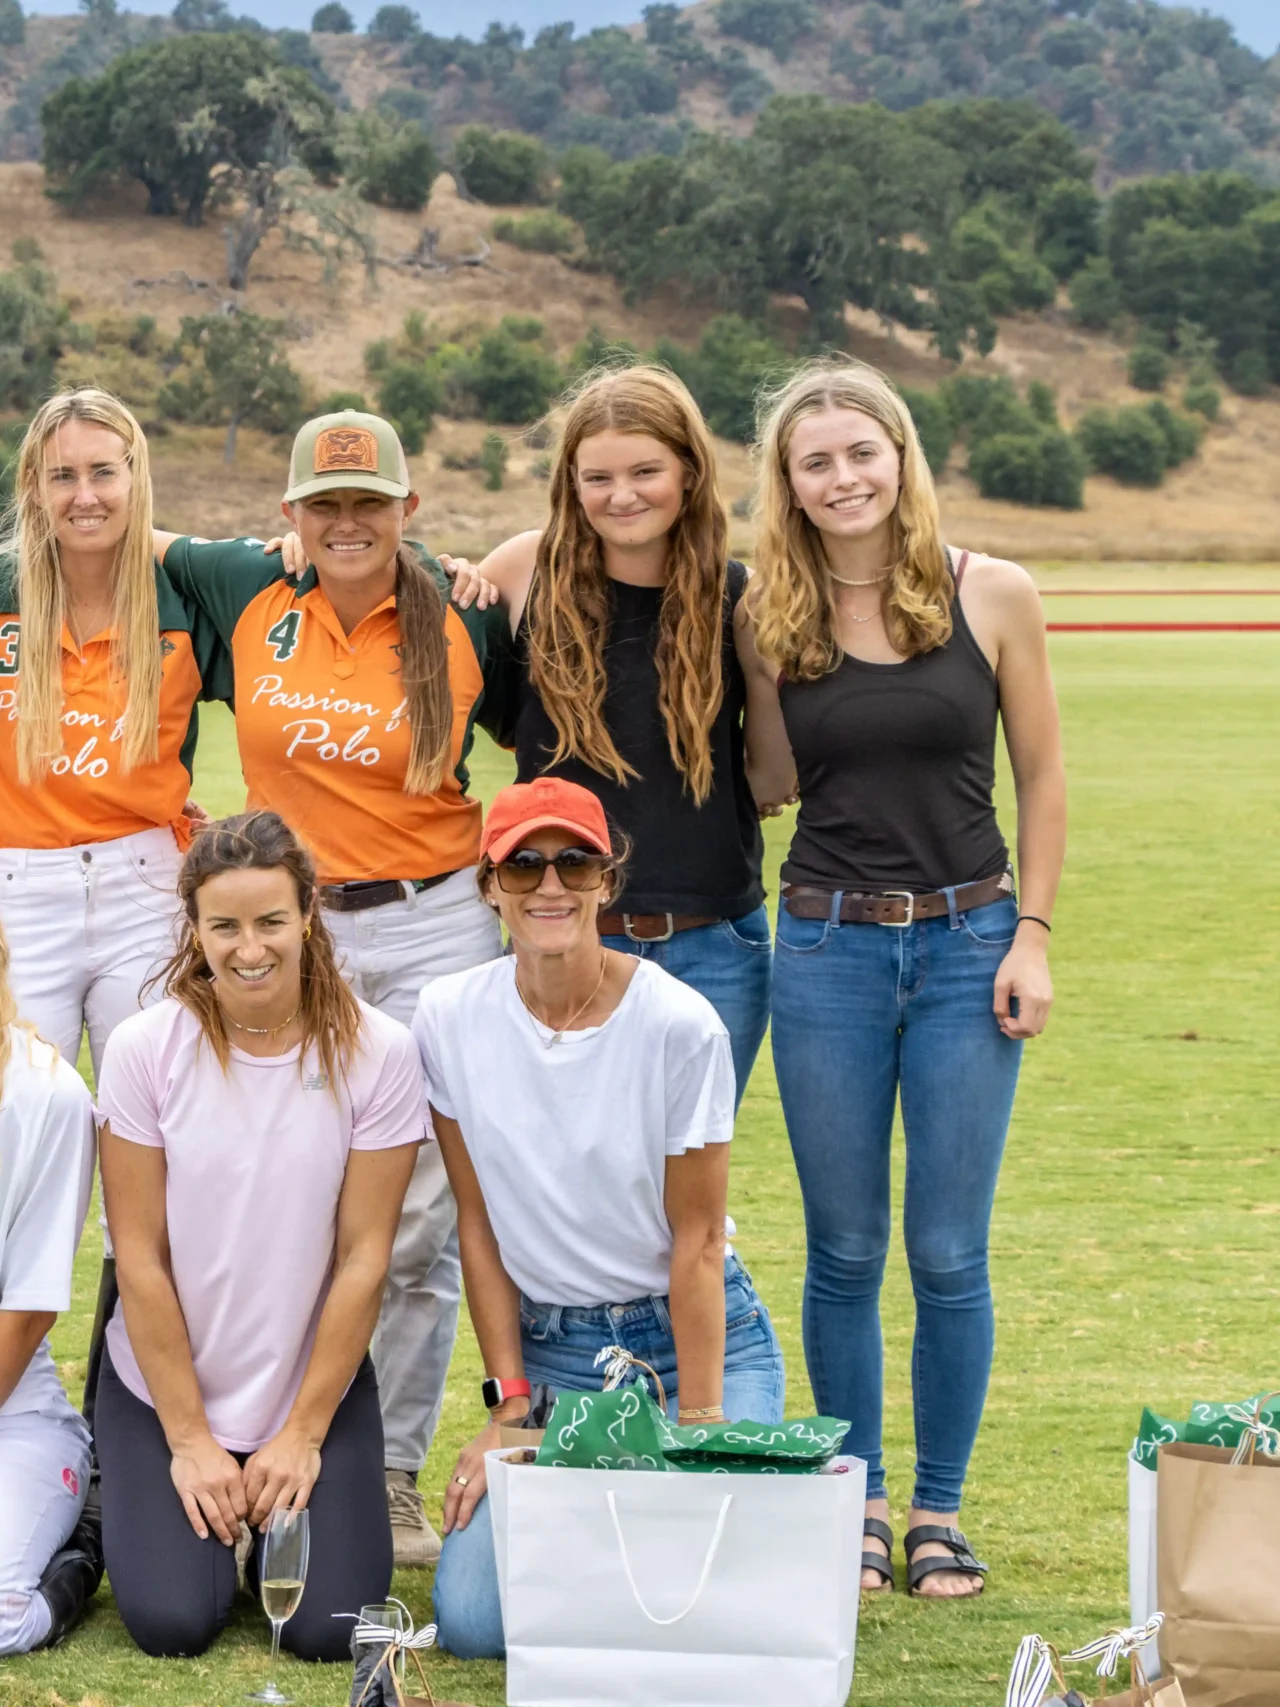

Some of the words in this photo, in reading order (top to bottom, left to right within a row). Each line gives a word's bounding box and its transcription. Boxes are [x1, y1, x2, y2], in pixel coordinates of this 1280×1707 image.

[265, 610, 303, 662] 4
[252, 675, 380, 716] Passion
[38, 737, 109, 778] olo
[282, 719, 380, 766] Polo
